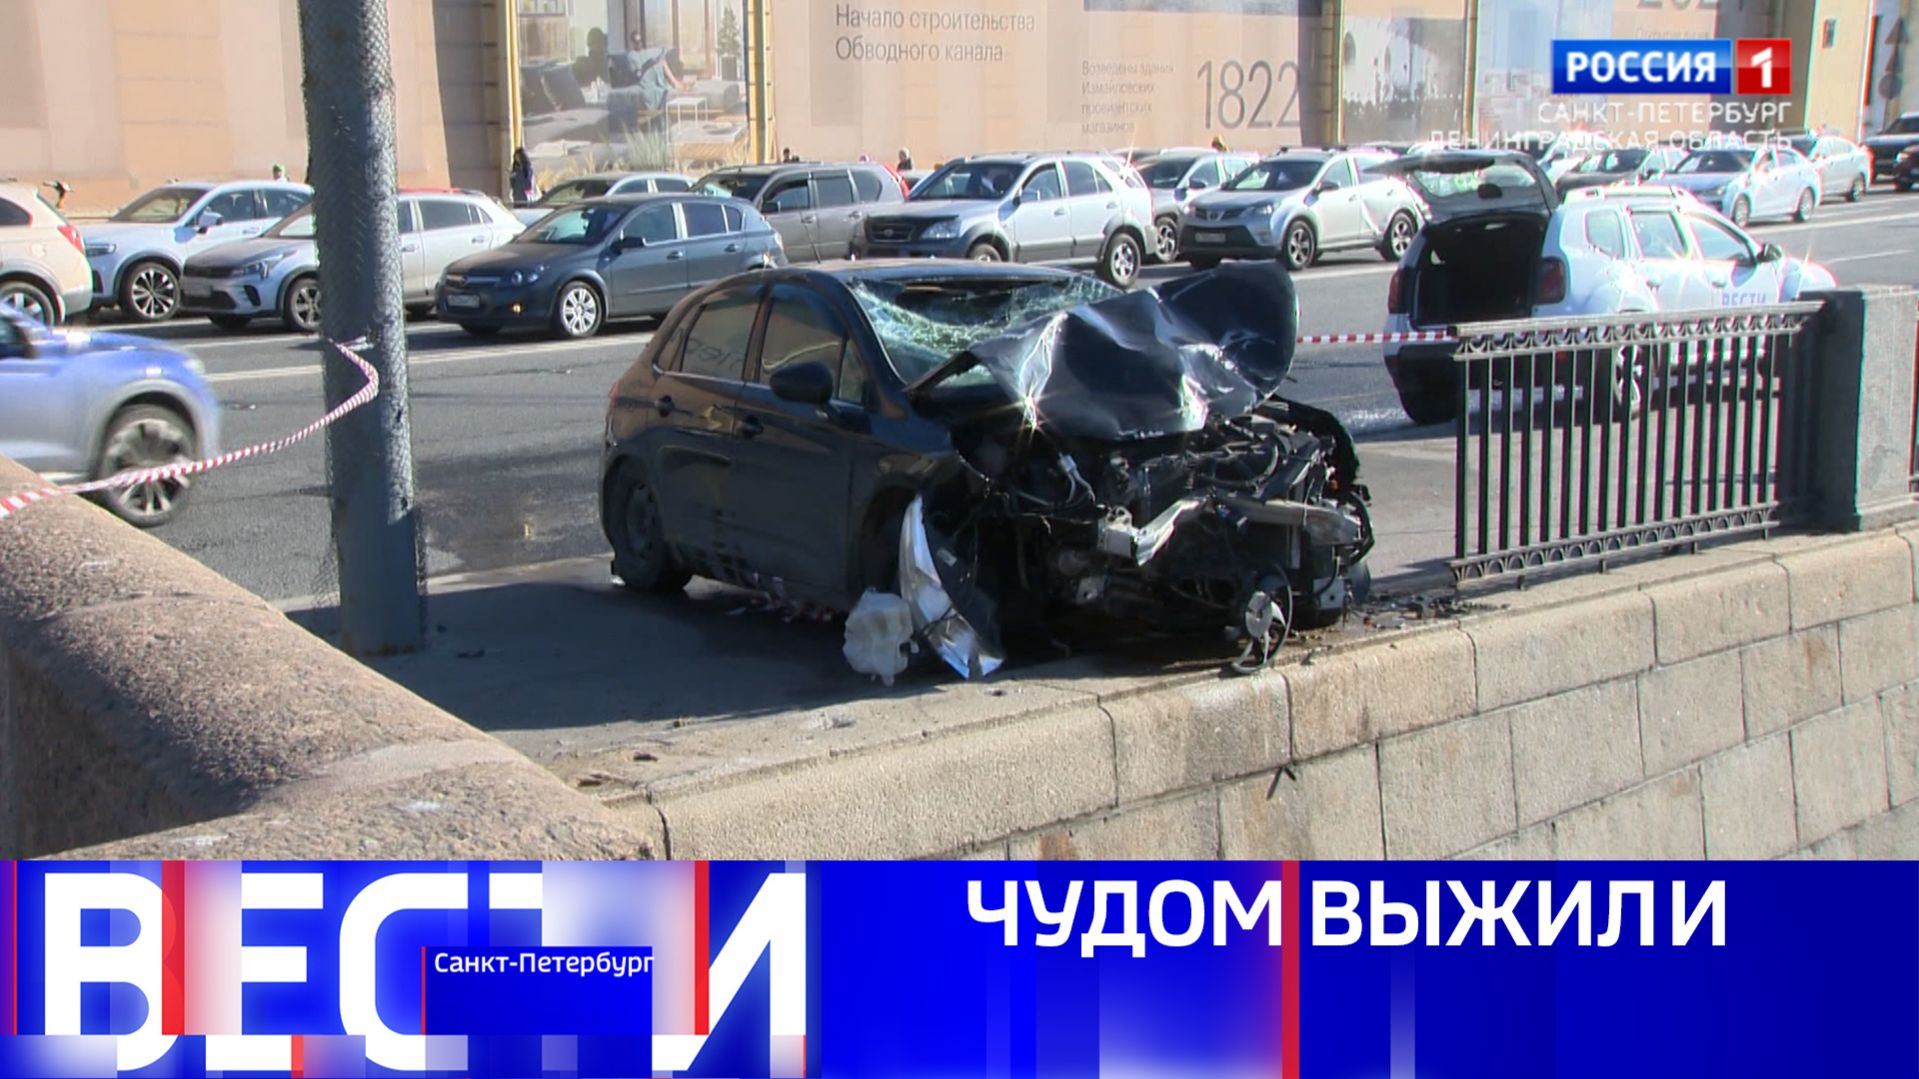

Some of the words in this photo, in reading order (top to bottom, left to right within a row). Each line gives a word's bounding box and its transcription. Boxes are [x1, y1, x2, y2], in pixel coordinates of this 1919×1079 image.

[836, 3, 904, 28] Начало
[909, 10, 1035, 33] строительства
[836, 35, 940, 63] Обводного
[945, 43, 1003, 62] канала
[1197, 60, 1300, 129] 1822
